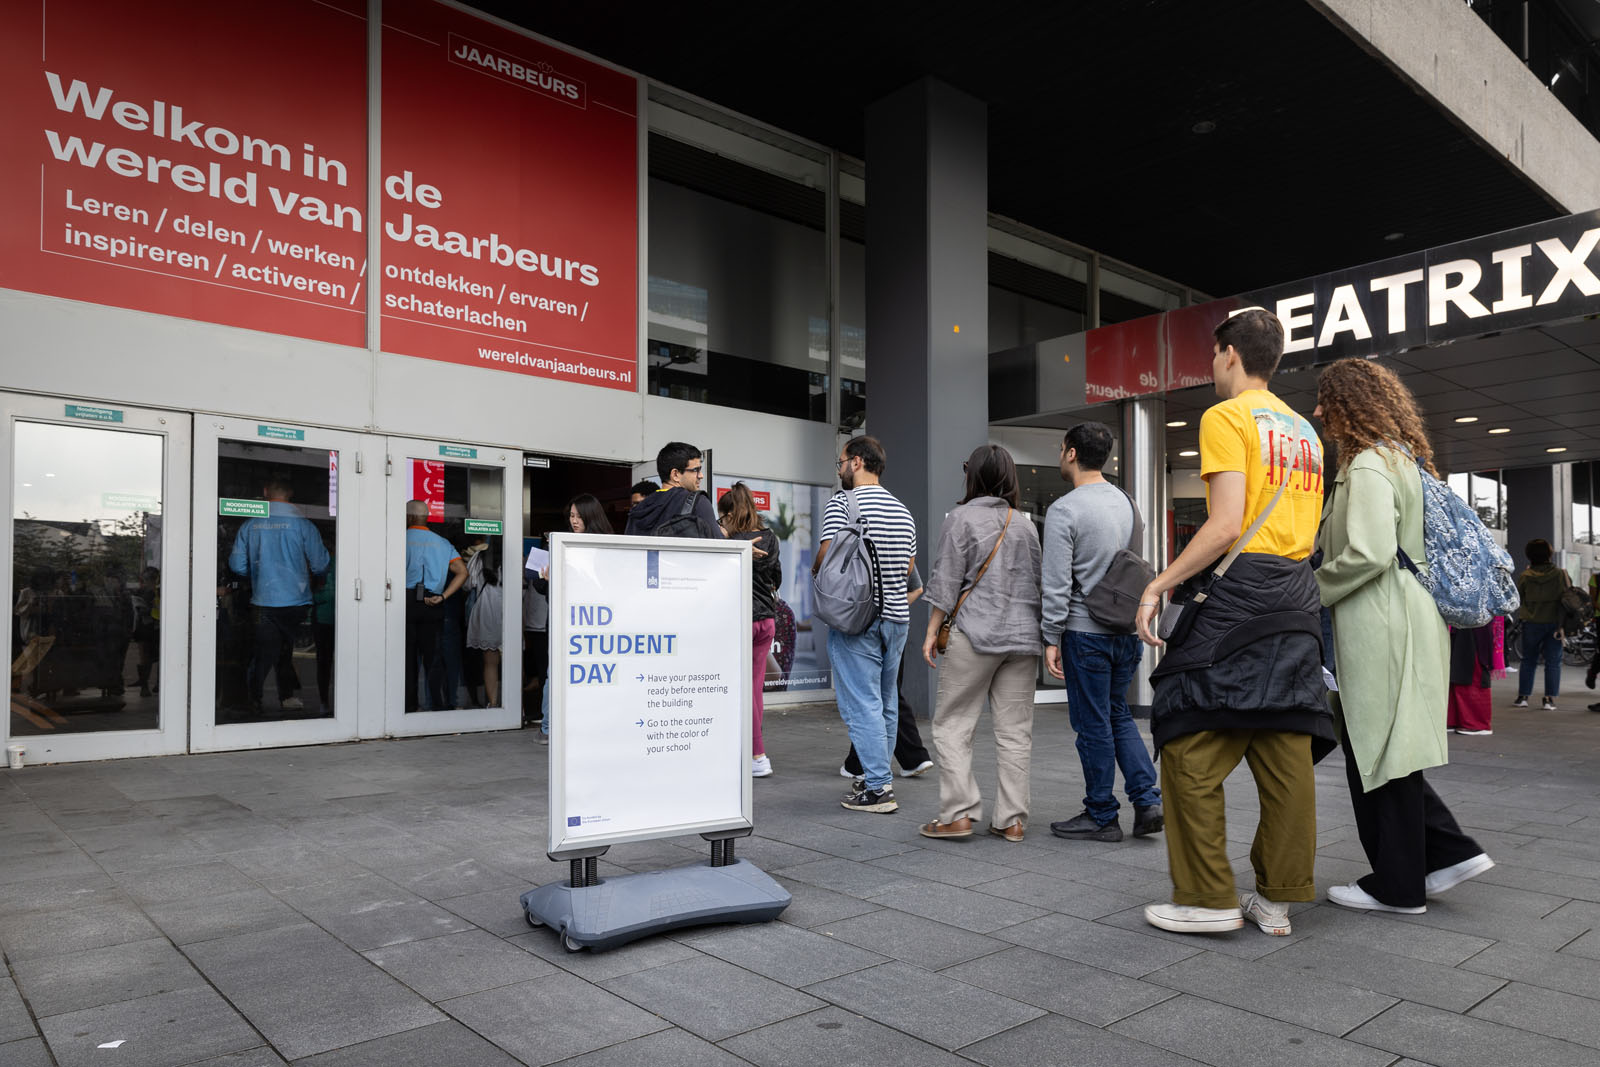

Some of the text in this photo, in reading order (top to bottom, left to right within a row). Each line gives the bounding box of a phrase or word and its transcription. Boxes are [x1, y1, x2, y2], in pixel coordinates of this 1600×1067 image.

[455, 45, 579, 100] JAARBEURS
[45, 71, 442, 209] Welkom in de
[45, 130, 600, 287] wereld van Jaarbeurs
[66, 189, 149, 226] Leren
[173, 215, 246, 247] delen
[268, 238, 355, 271] werken
[385, 262, 494, 299] ontdekken
[509, 291, 577, 317] ervaren
[65, 224, 209, 271] inspireren
[232, 262, 345, 299] activeren
[385, 293, 527, 333] schaterlachen
[1228, 228, 1600, 357] EATRIX
[478, 346, 632, 383] wereldvanjaarbeurs.nl
[570, 605, 613, 626] IND
[569, 634, 677, 655] STUDENT
[569, 663, 617, 684] DAY
[647, 673, 720, 683] Have your passport
[647, 684, 728, 696] ready before entering
[647, 698, 693, 708] the building
[647, 717, 713, 727] Go to the counter
[647, 728, 709, 740] with the color of
[647, 743, 691, 755] your school
